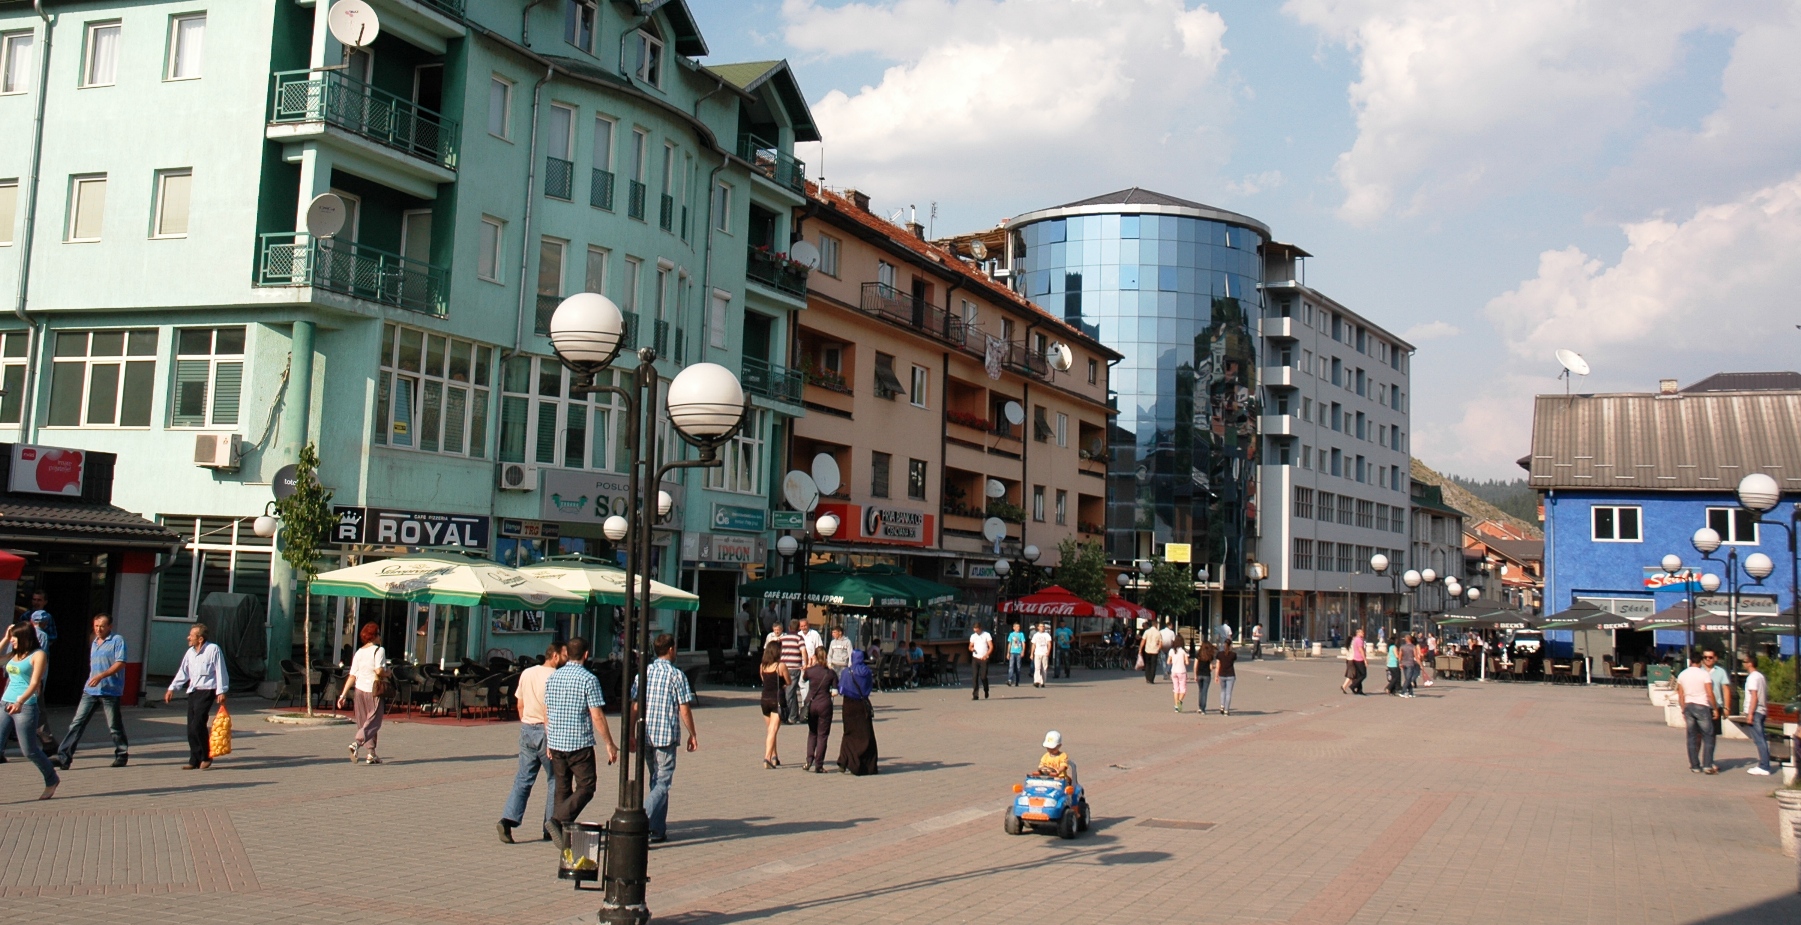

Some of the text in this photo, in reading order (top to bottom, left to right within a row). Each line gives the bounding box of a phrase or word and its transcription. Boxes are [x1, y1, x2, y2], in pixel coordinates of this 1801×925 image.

[595, 481, 644, 493] POSLONI
[338, 525, 357, 540] R
[377, 519, 478, 546] ROYAL
[717, 545, 751, 561] IPPON
[763, 590, 781, 598] CAFÉ
[821, 594, 845, 604] IPPON
[1740, 599, 1772, 608] Skala
[1619, 604, 1650, 614] Skala
